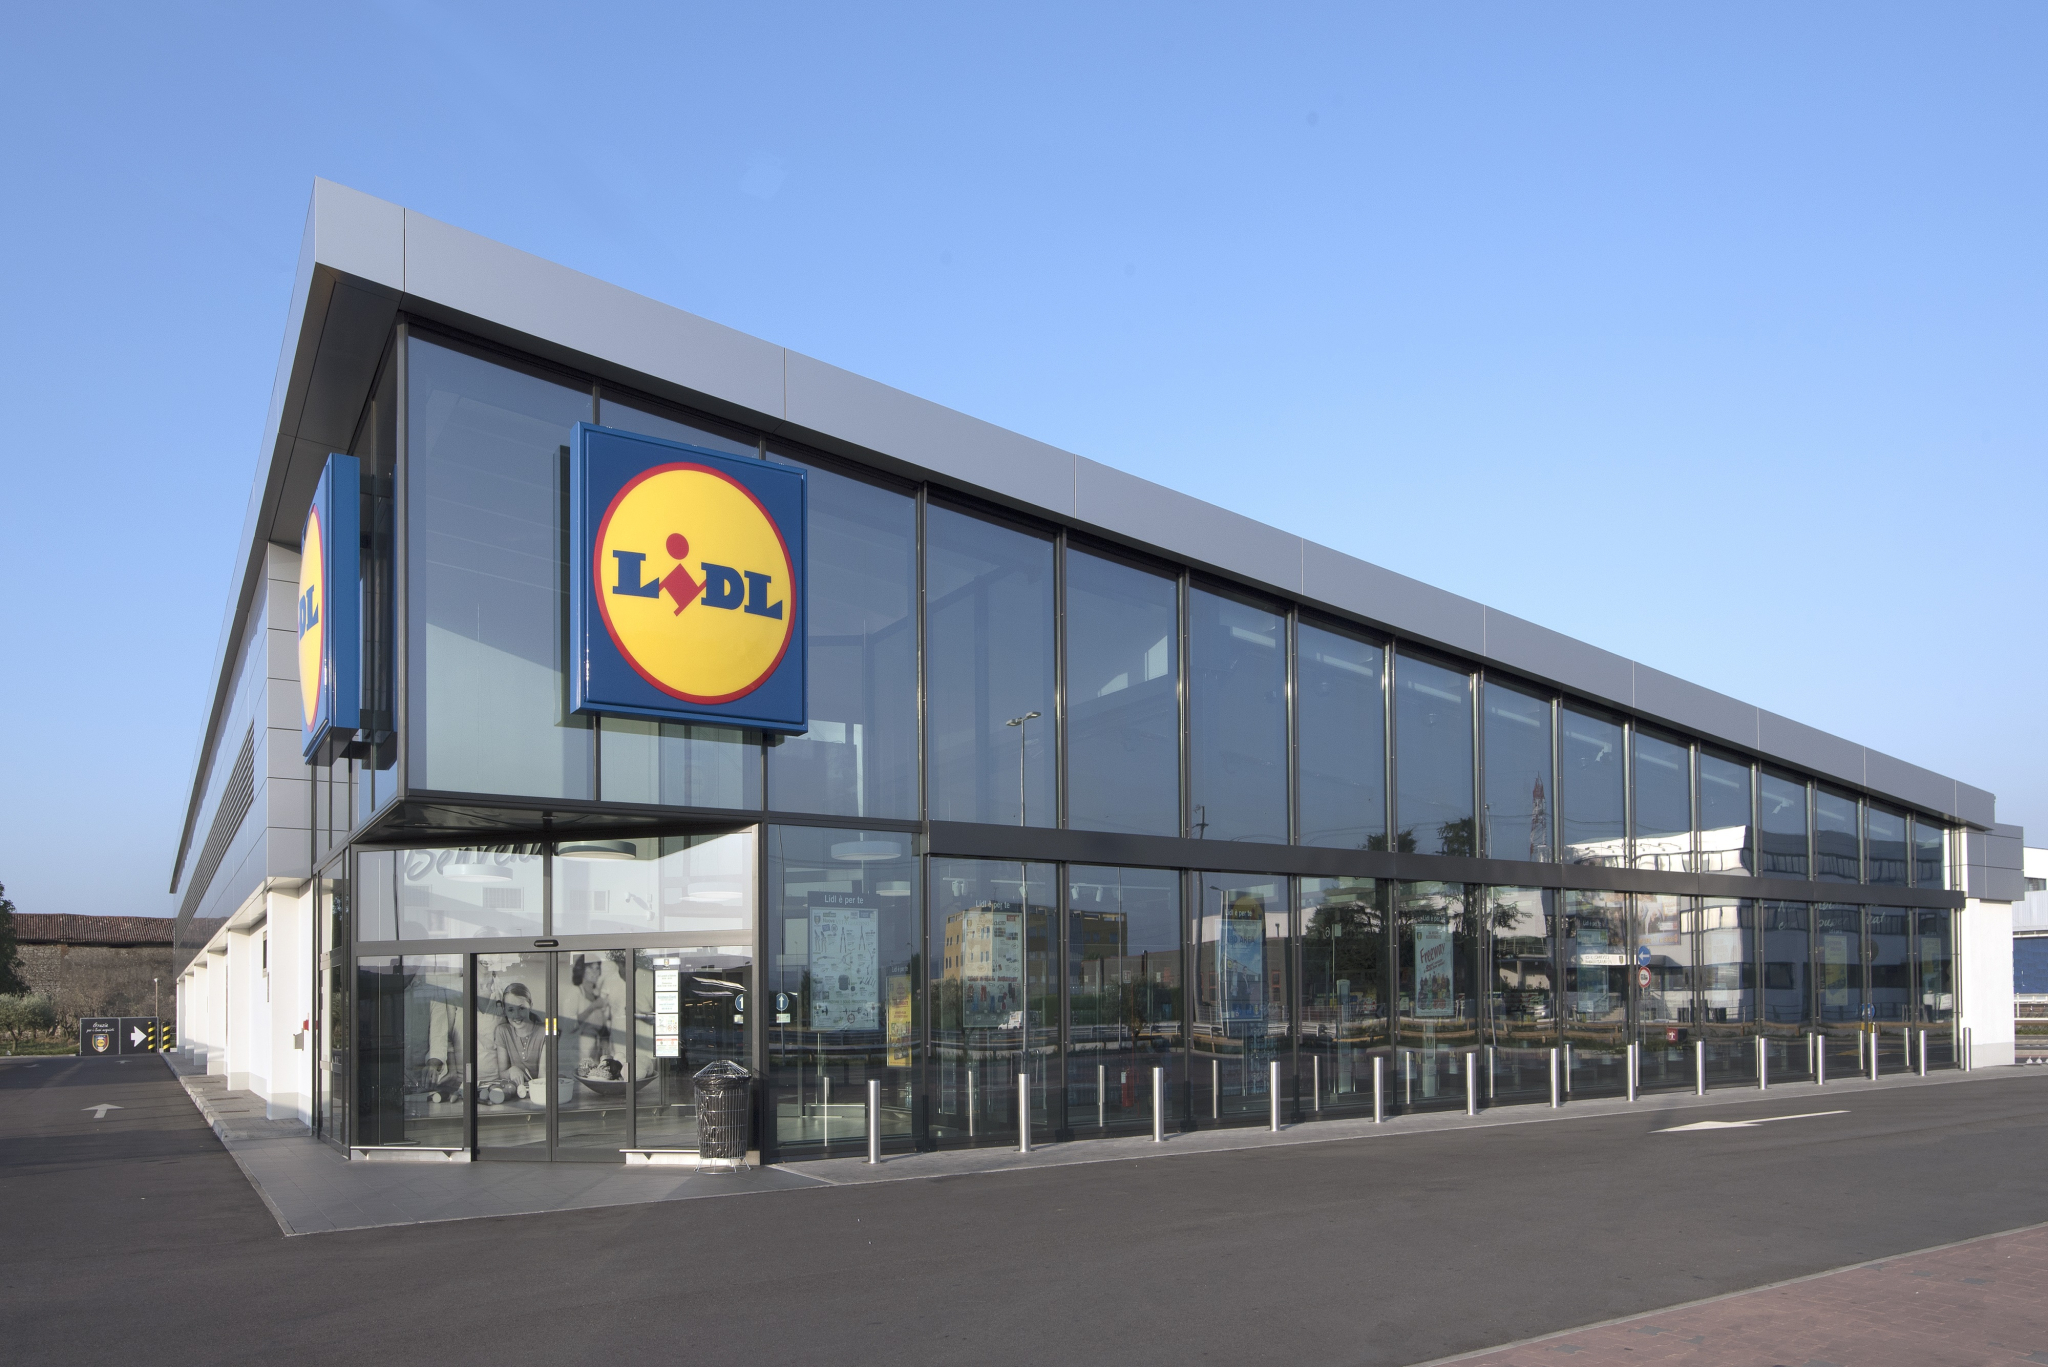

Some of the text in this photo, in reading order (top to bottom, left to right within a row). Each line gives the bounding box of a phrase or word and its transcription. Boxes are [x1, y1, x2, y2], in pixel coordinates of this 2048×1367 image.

[824, 894, 864, 905] Lidl è per te
[975, 899, 987, 908] Lidl
[1004, 901, 1010, 909] te
